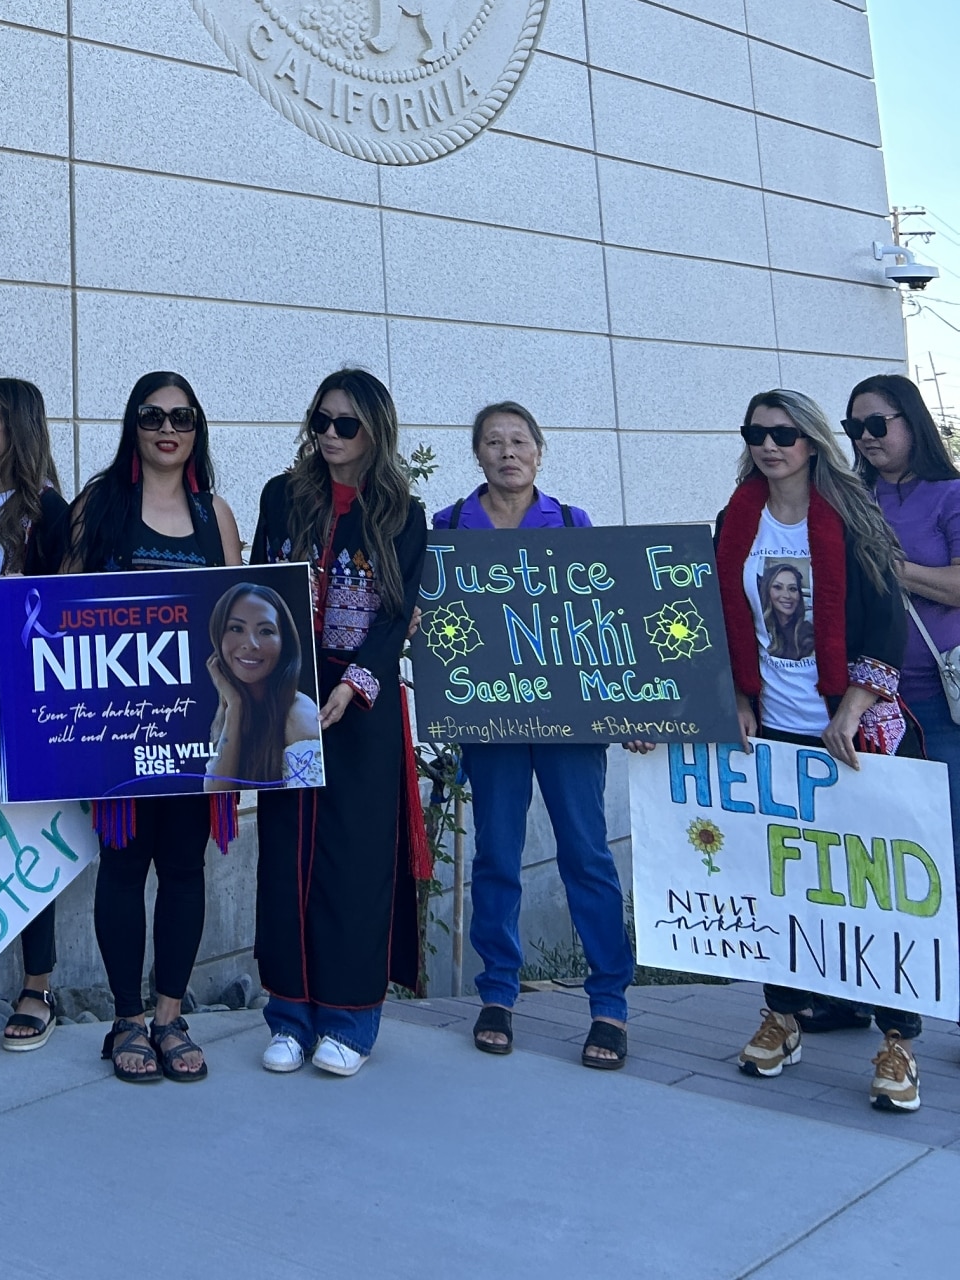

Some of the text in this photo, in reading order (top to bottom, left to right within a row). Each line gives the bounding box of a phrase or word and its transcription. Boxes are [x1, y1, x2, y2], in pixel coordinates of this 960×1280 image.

[248, 18, 479, 132] CALIFORNIA
[419, 545, 712, 600] Justice For
[750, 548, 778, 557] ustice
[59, 606, 188, 629] JUSTICE FOR
[503, 599, 637, 666] Nikki
[32, 630, 192, 692] NIKKI
[445, 667, 680, 704] Saelee McCain
[49, 722, 167, 744] will end and the
[70, 702, 96, 723] the
[102, 700, 152, 720] darkest
[151, 697, 196, 723] night
[427, 716, 574, 743] #BringNikkiHome
[134, 742, 218, 761] SUN WILL
[668, 742, 839, 822] HELP
[767, 823, 942, 918] FIND
[789, 914, 940, 1002] NIKKI
